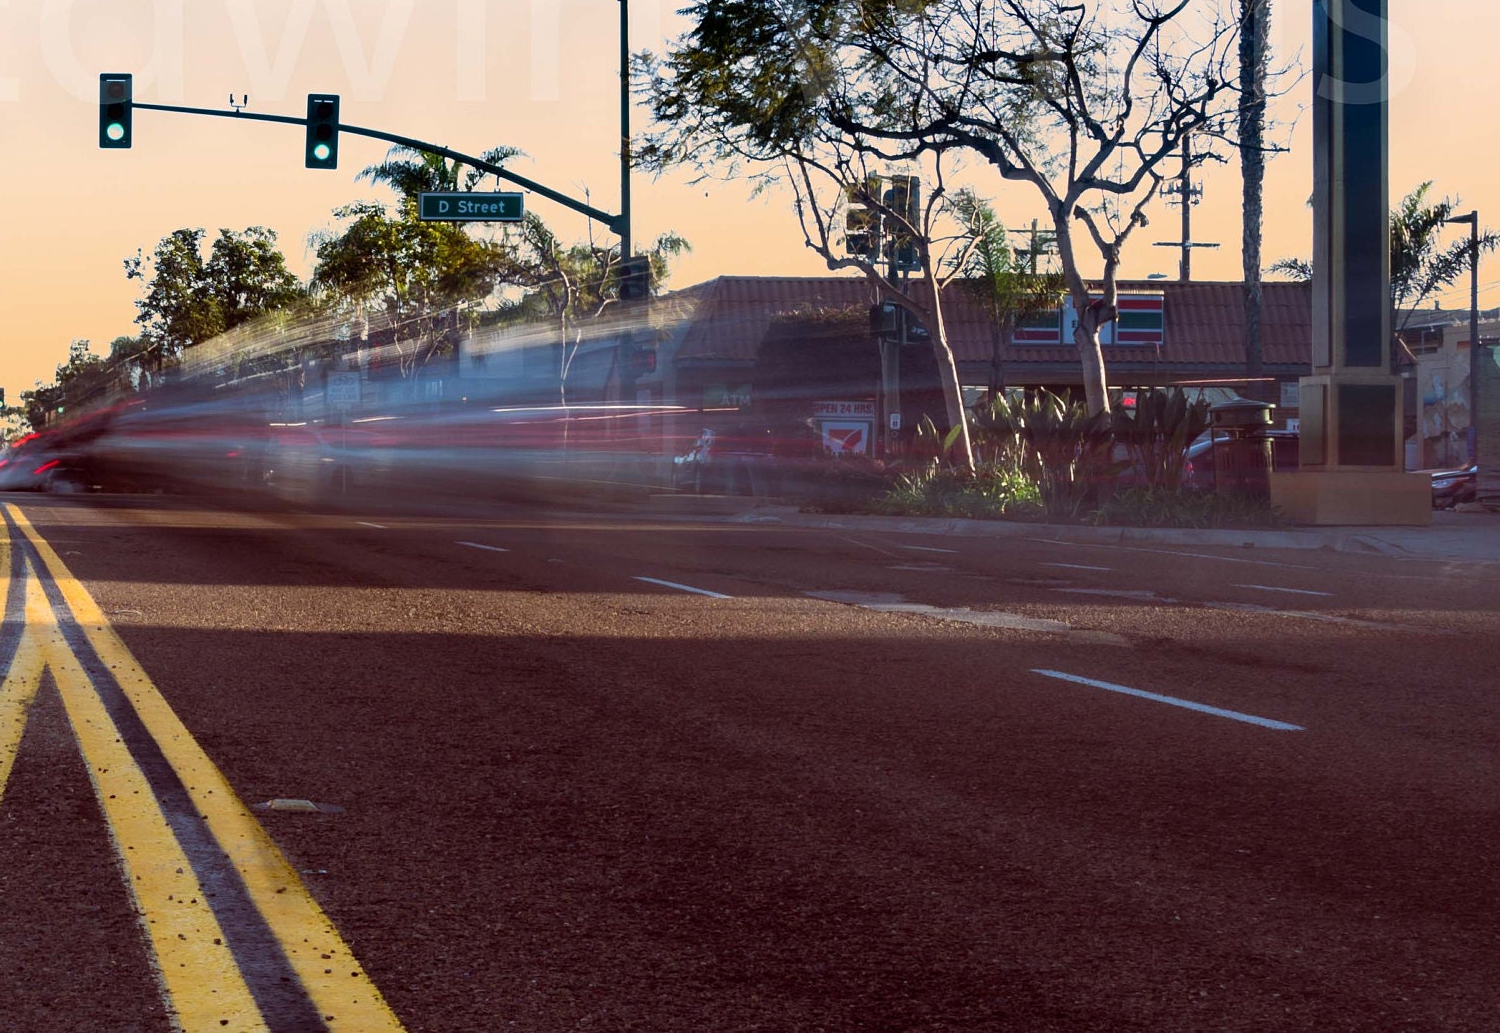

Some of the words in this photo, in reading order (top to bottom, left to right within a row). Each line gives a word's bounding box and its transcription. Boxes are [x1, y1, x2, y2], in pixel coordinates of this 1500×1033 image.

[438, 200, 449, 213] D
[457, 200, 505, 213] Street
[720, 394, 751, 407] ATM
[840, 404, 850, 413] 24
